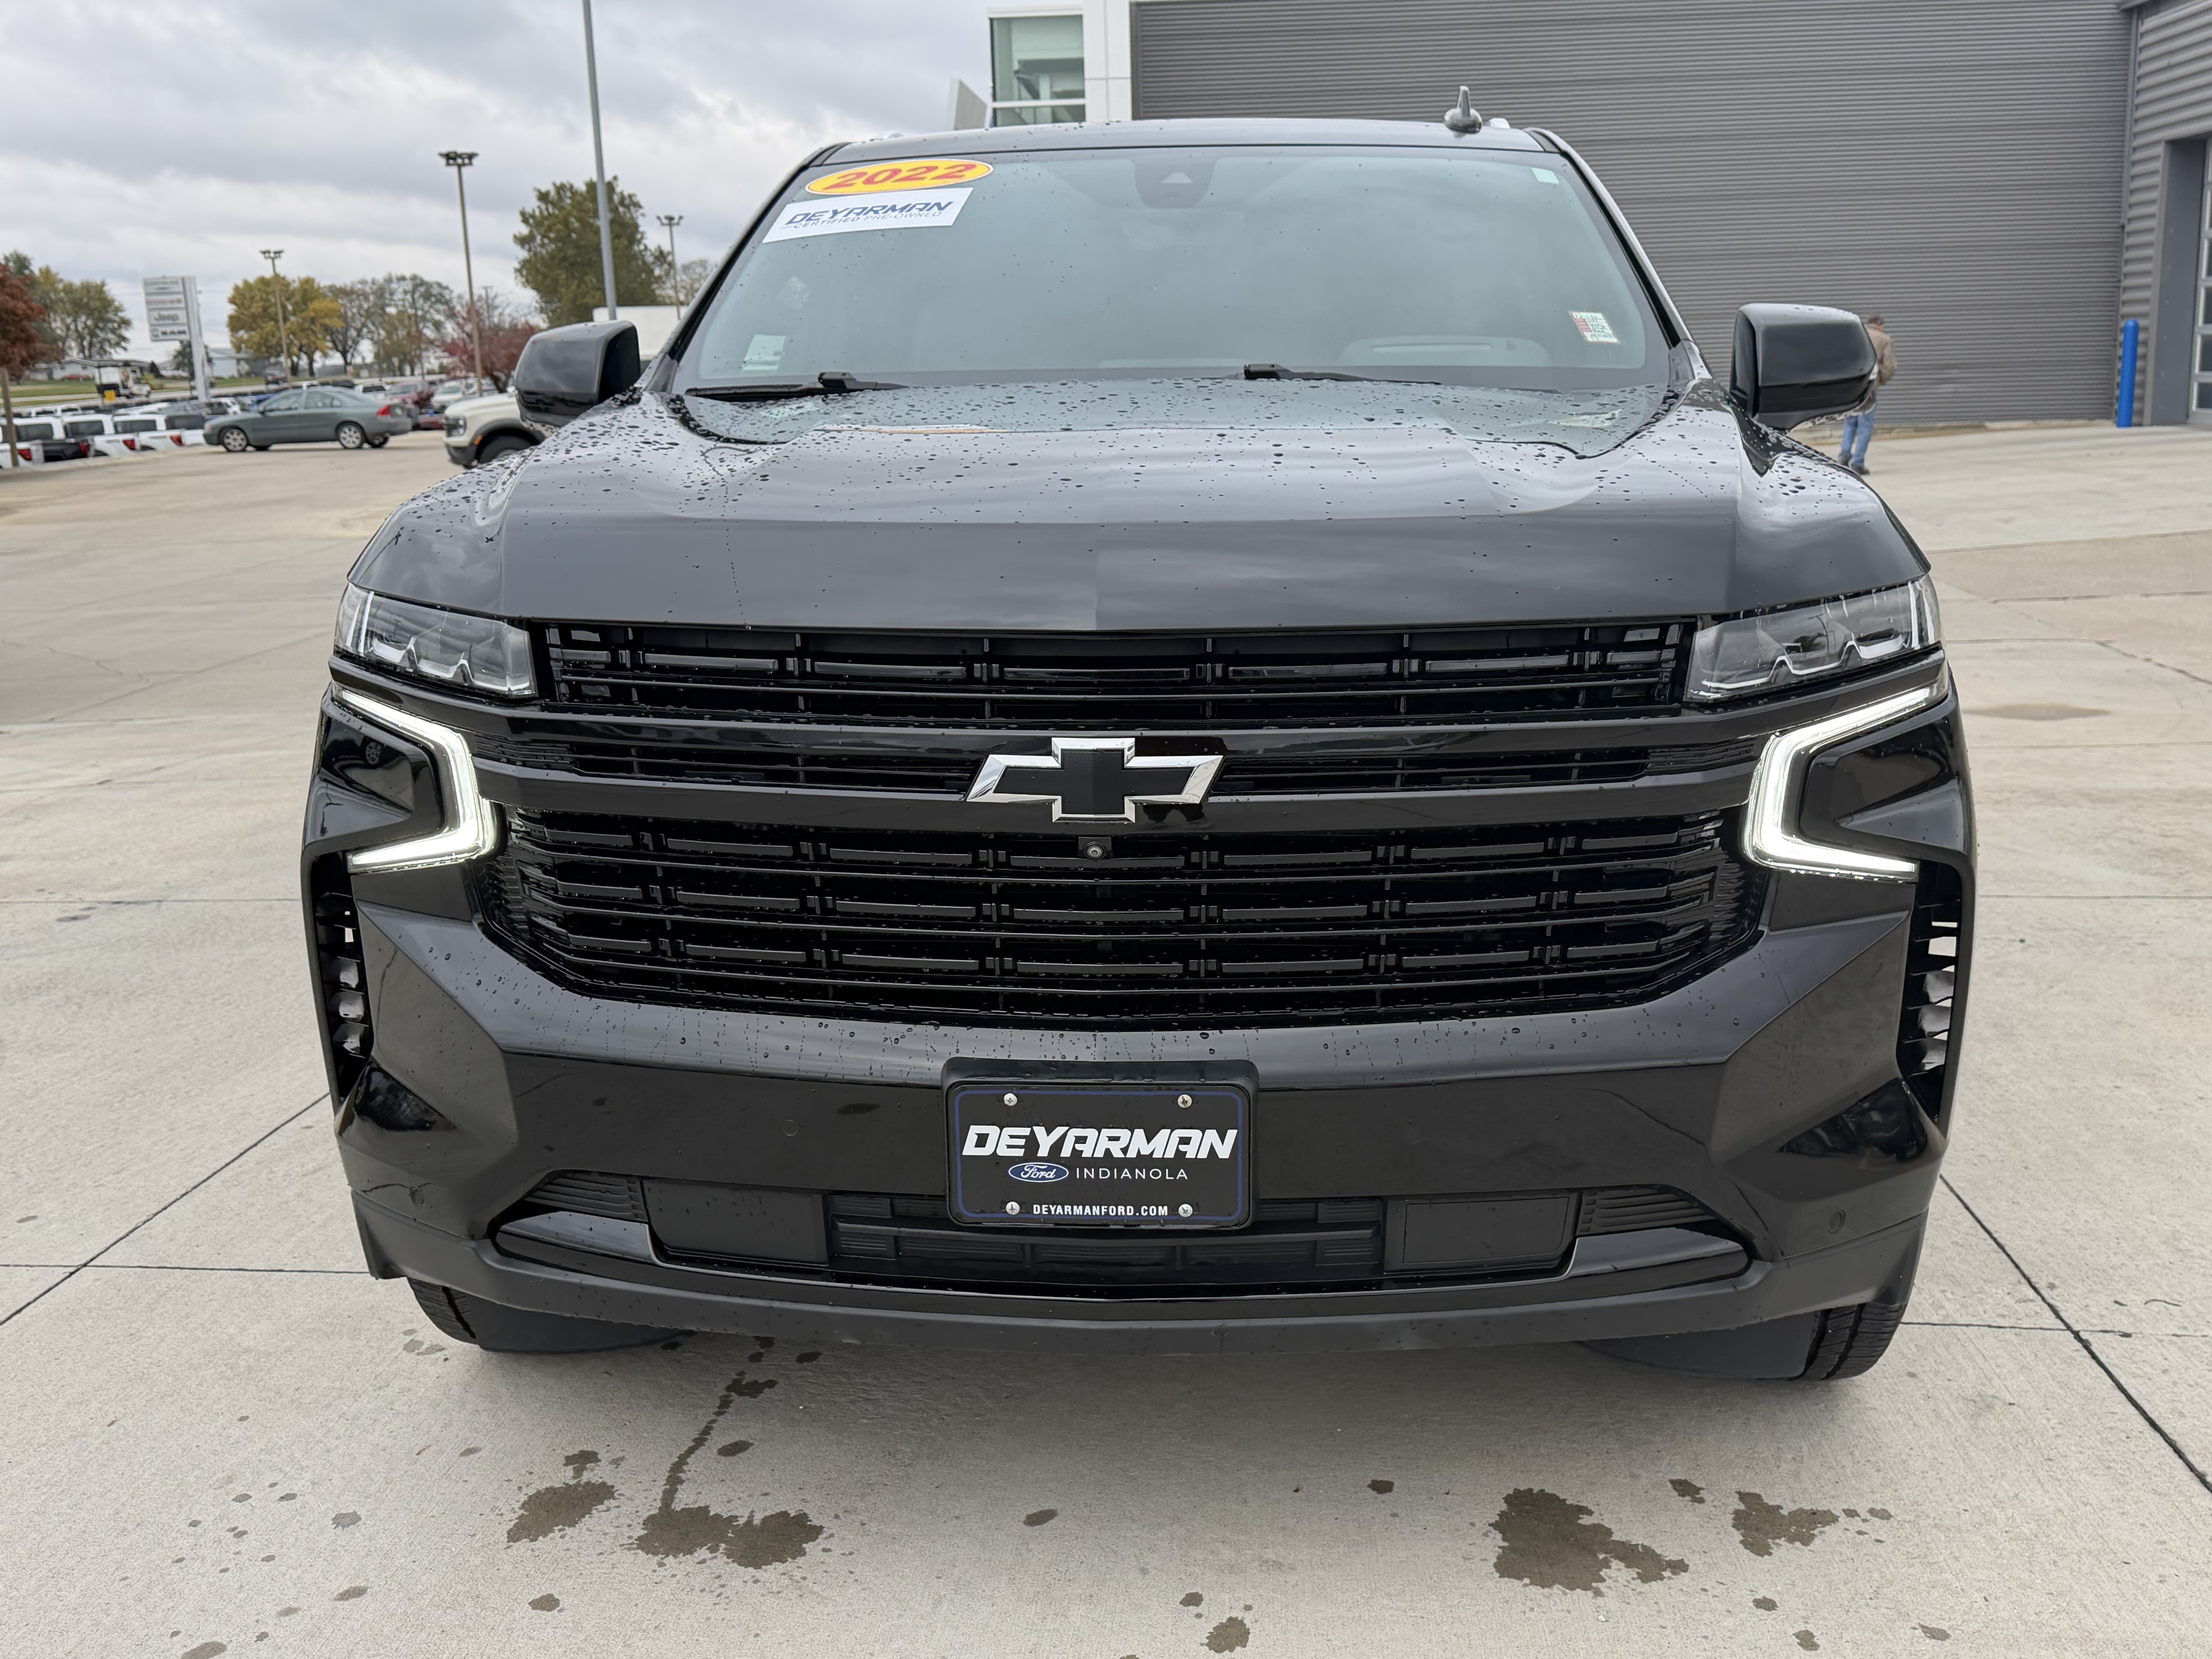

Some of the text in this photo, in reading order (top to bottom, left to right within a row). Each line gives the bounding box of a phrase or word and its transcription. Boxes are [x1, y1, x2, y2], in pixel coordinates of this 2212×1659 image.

[822, 164, 977, 190] 2022
[785, 201, 954, 225] DEYARMAN
[794, 211, 942, 228] CERTIFIED PRE-OWNED
[962, 1125, 1238, 1158] DEYARMAN
[1020, 1164, 1188, 1180] Ford INDIANOLA
[1033, 1204, 1168, 1216] DEYARMANFORD.COM
